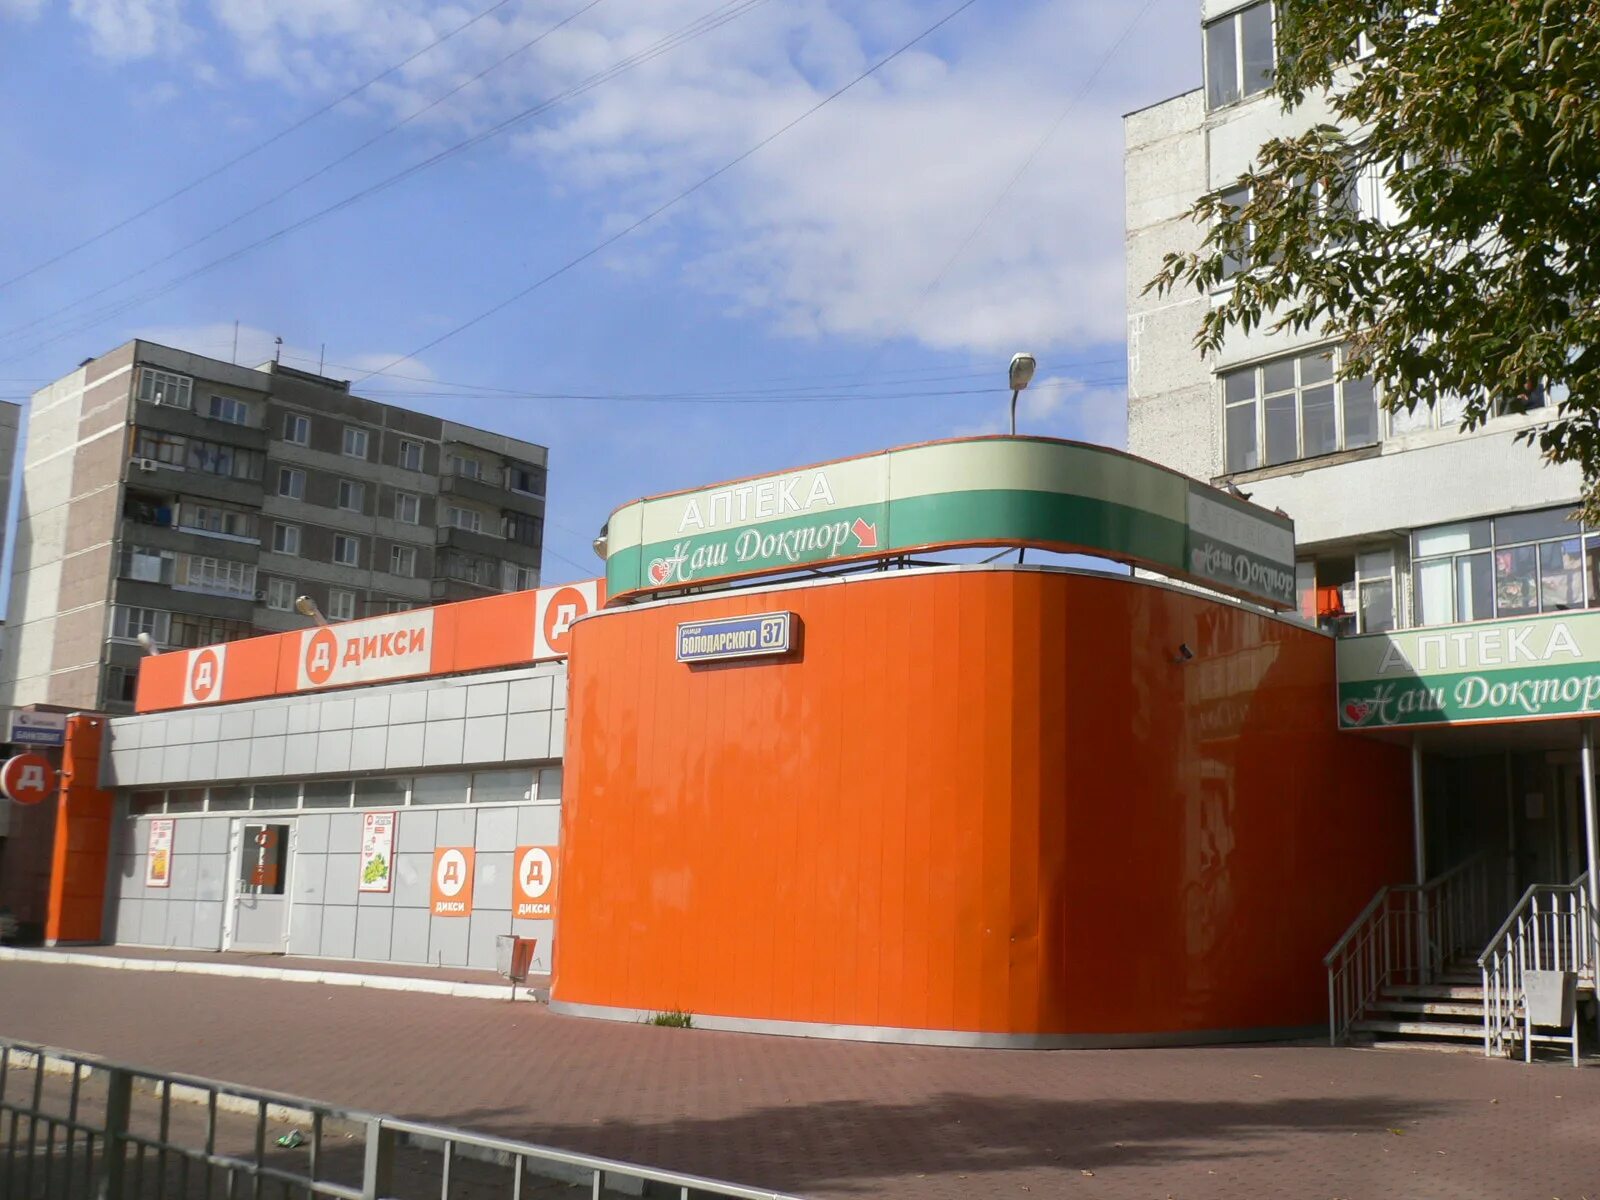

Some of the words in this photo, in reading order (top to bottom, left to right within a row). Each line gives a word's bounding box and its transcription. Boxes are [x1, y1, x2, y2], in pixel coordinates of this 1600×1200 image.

[677, 472, 836, 533] АПТЕКА
[664, 540, 728, 582] Наш
[735, 520, 850, 562] Доктор
[1200, 542, 1234, 574] Наш
[1234, 555, 1294, 600] Доктор
[342, 627, 426, 668] ДИКСИ
[682, 627, 702, 637] улица
[682, 629, 757, 655] ВОЛОДАРСКОГО
[763, 621, 783, 644] 37
[1376, 622, 1583, 675] АПТЕКА
[1362, 682, 1447, 725] Наш
[16, 764, 45, 792] Д
[443, 861, 459, 885] Д
[526, 860, 543, 885] Д
[435, 901, 465, 913] ДИКСИ
[518, 903, 551, 915] ДИКСИ
